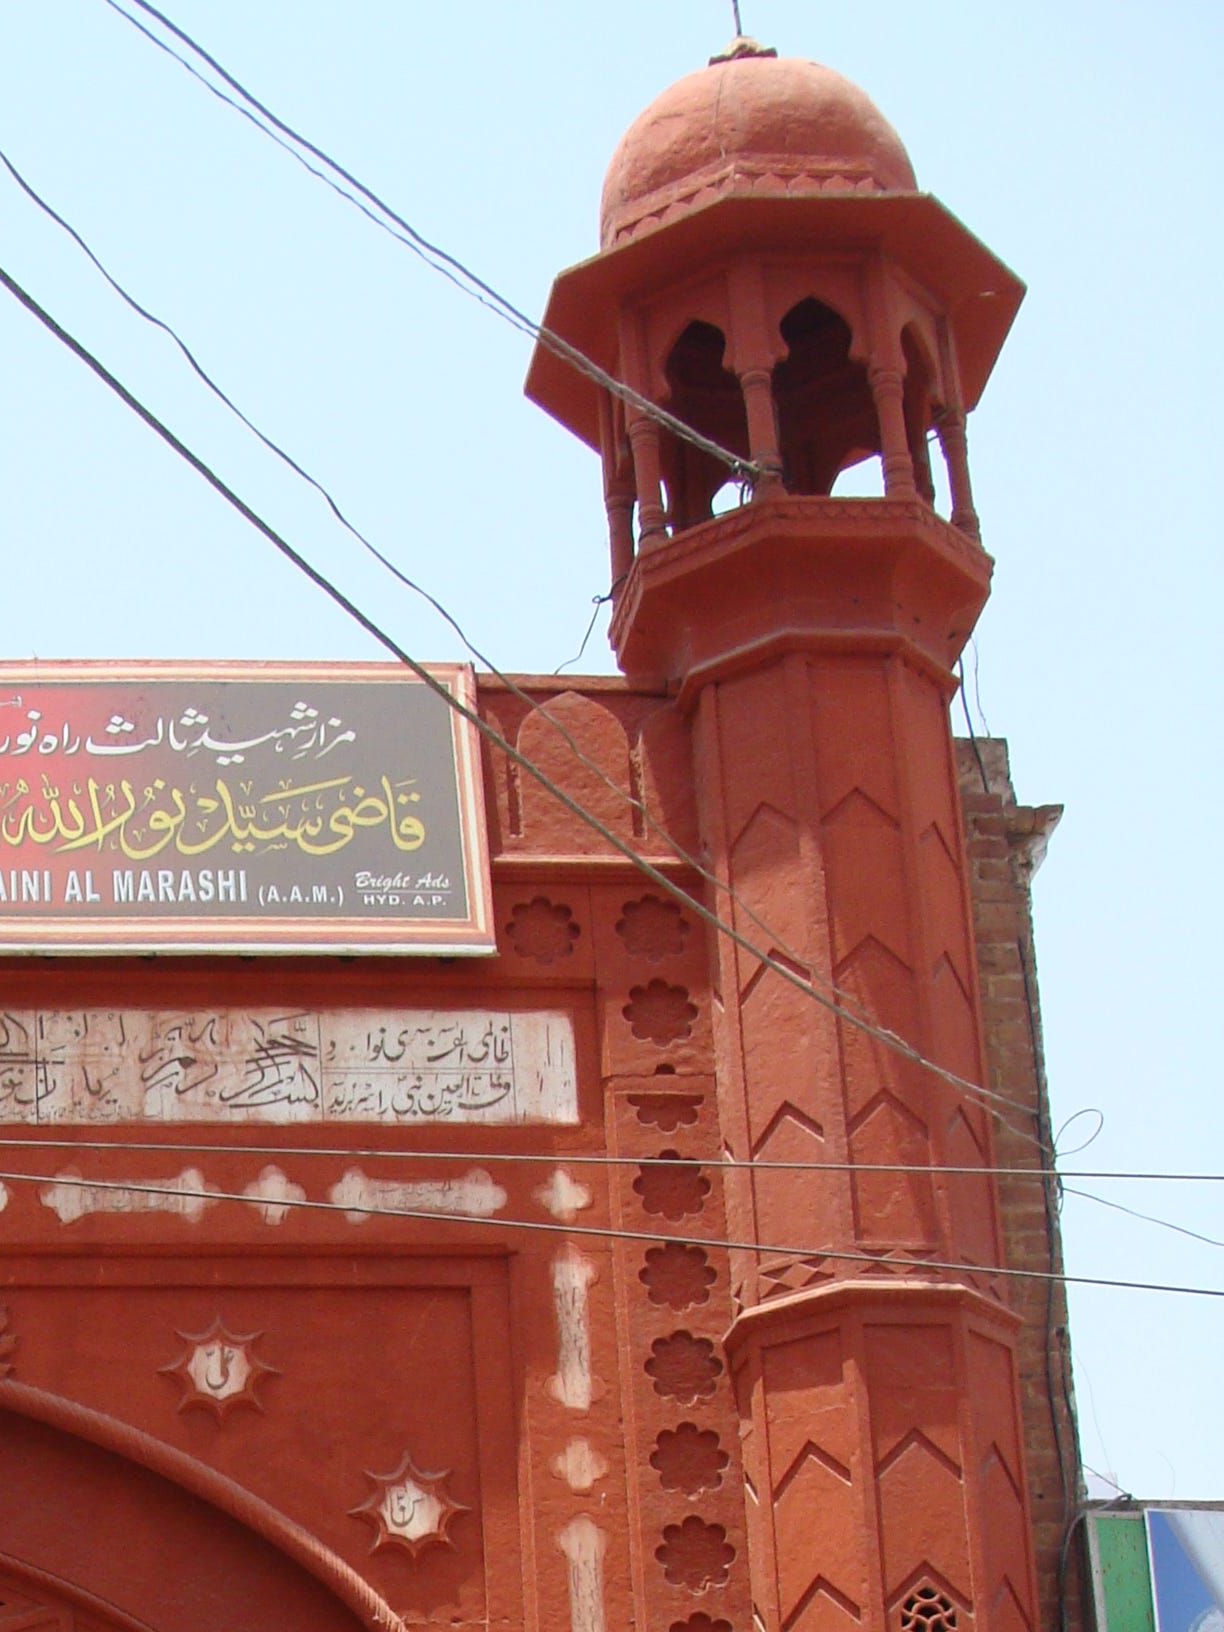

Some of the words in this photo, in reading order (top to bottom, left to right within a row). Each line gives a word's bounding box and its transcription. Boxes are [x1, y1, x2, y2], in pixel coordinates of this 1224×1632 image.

[64, 869, 100, 902] AL
[112, 869, 248, 902] MARASHI
[258, 885, 344, 907] (A.A.M.)
[355, 871, 411, 892] Bright
[415, 872, 450, 888] Ads
[363, 894, 406, 906] HYD.
[413, 894, 447, 906] A.P.
